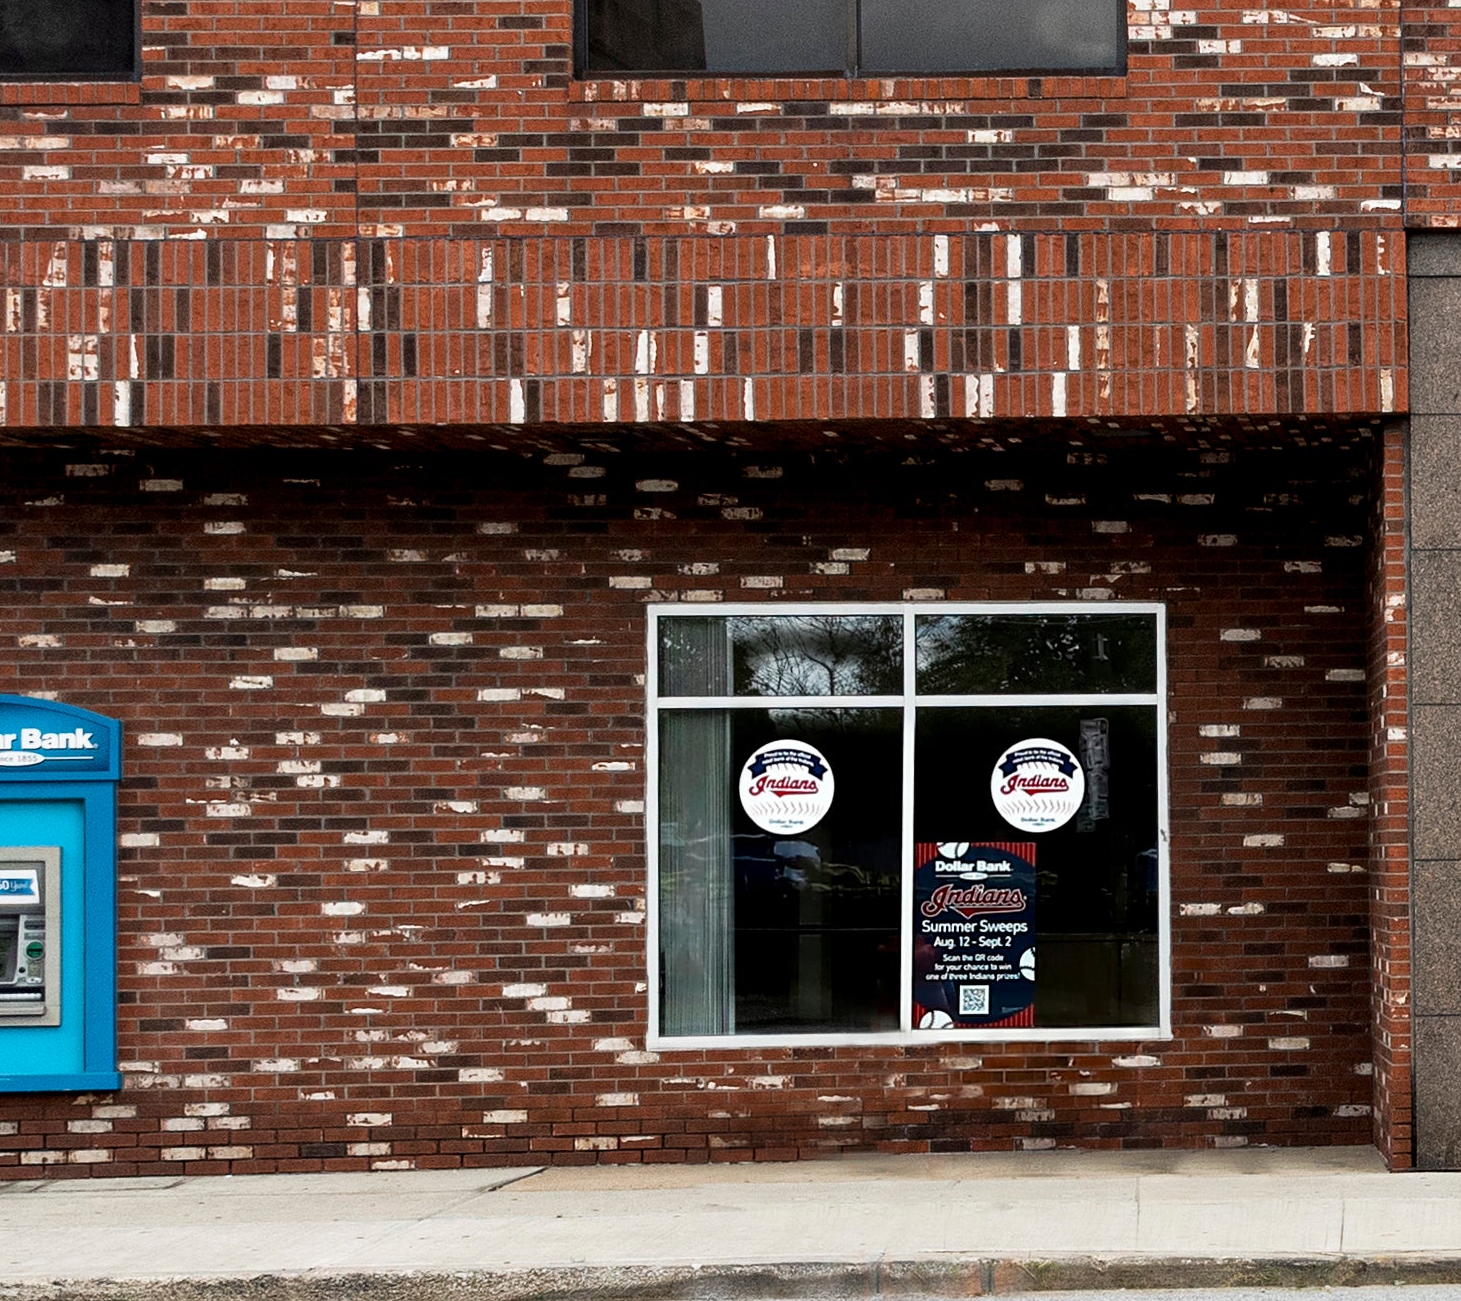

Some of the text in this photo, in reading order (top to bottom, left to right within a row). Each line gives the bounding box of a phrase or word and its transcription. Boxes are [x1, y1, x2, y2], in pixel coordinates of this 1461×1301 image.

[21, 727, 94, 750] Bank
[748, 775, 819, 798] Indians
[1000, 774, 1069, 796] Indians
[935, 860, 1012, 872] Dollar Bank
[920, 883, 1027, 920] Indians
[921, 919, 1029, 936] Summer Sweeps
[933, 936, 956, 950] Aug.
[959, 936, 970, 947] 12
[979, 936, 1003, 949] Sept.
[1005, 936, 1012, 947] 2
[942, 954, 961, 962] Scan
[962, 954, 973, 962] the
[987, 953, 1004, 962] code
[934, 963, 1012, 973] for your chance to win
